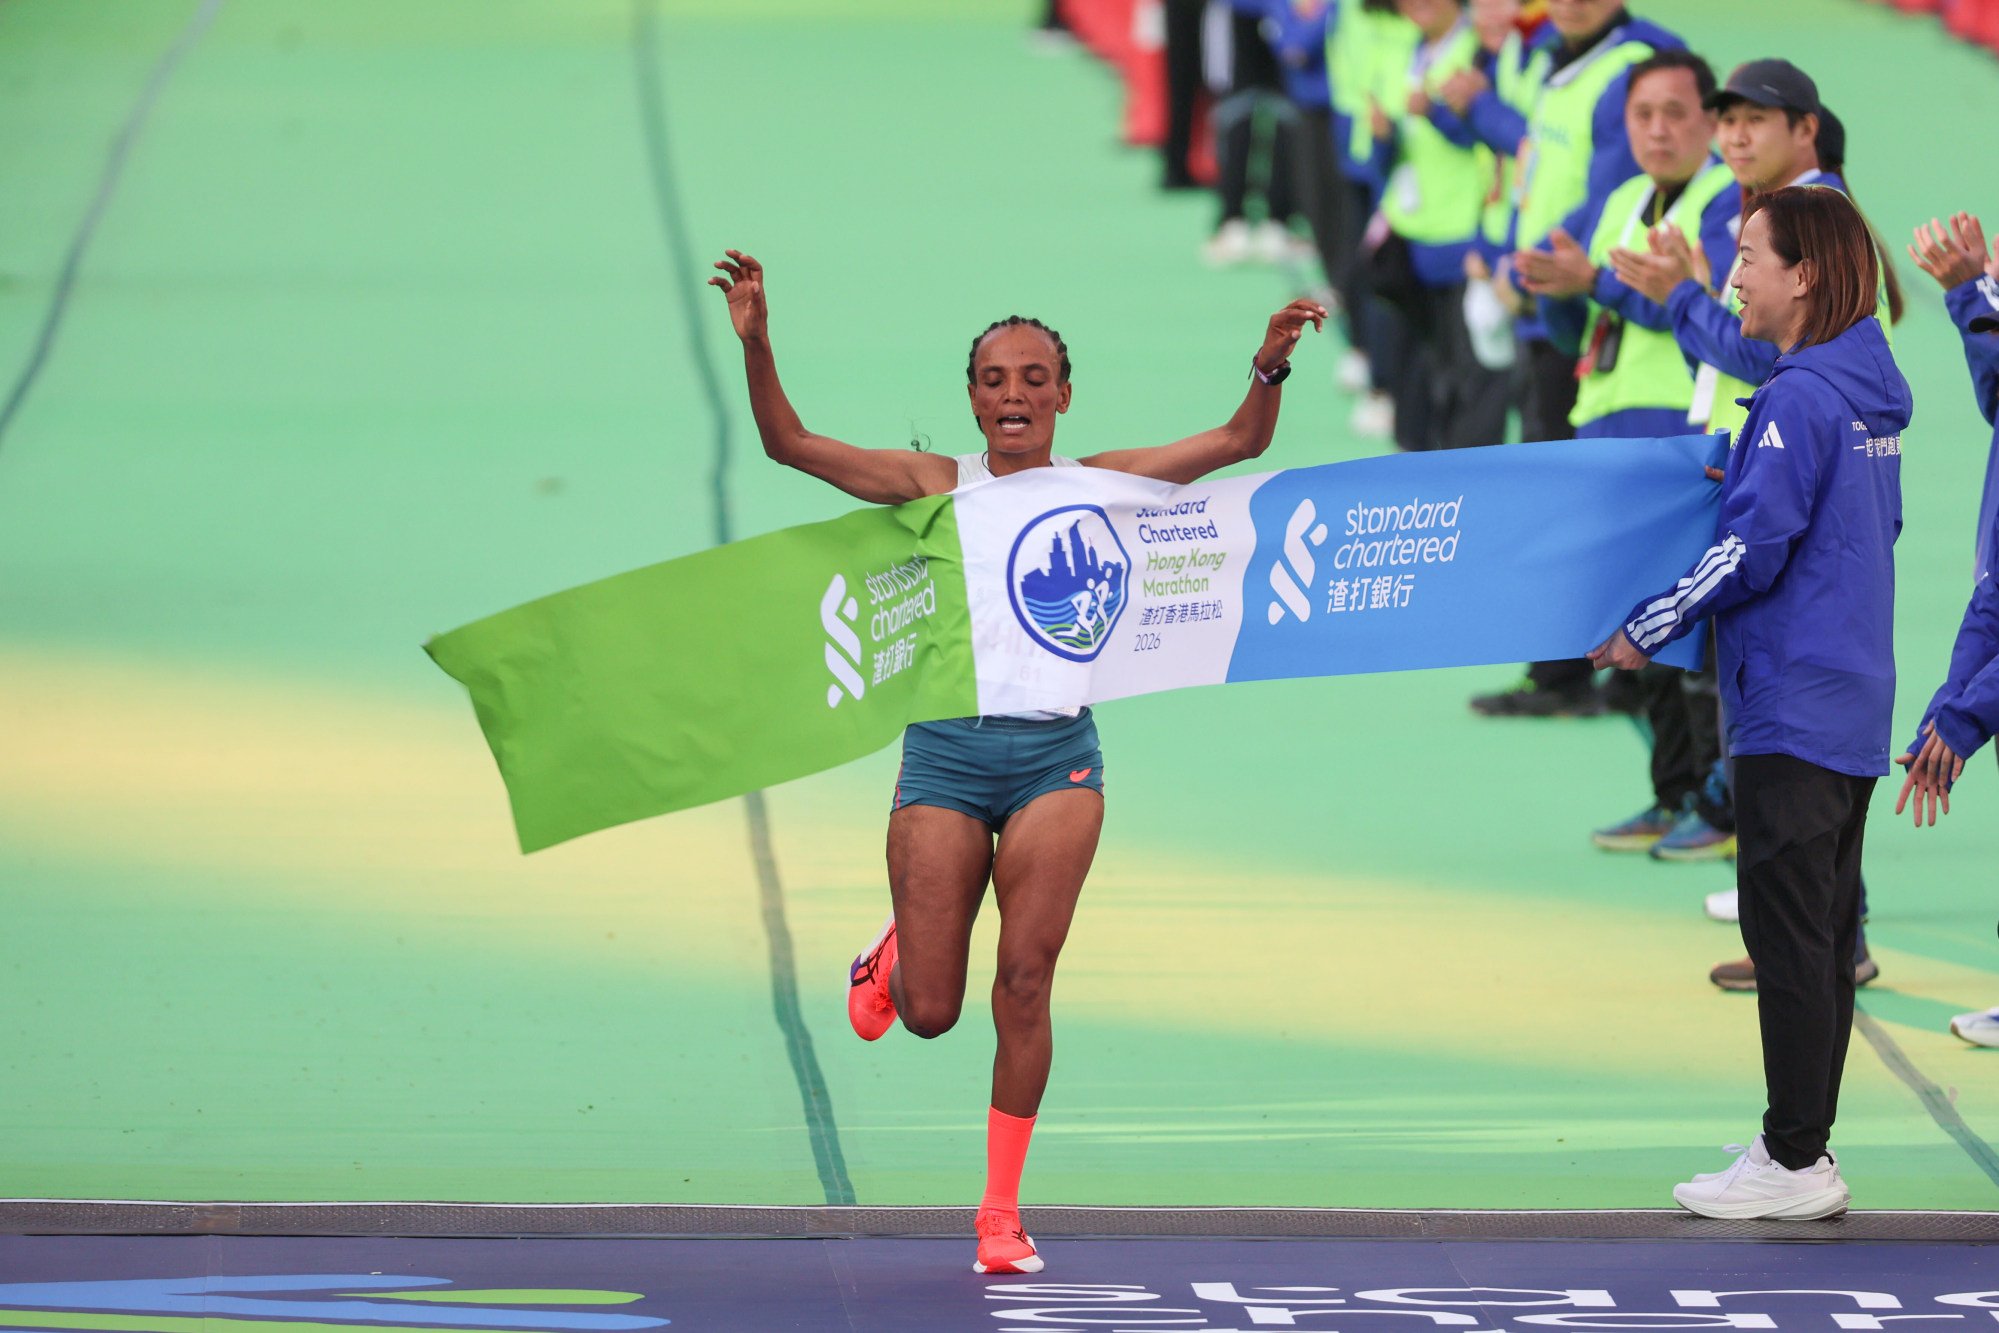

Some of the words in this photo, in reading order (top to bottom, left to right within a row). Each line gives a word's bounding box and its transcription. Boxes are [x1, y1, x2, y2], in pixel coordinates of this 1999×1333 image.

[1345, 495, 1464, 536] standard
[1139, 520, 1219, 544] Chartered
[1146, 552, 1184, 574] Hong
[1188, 548, 1228, 571] Kong
[1334, 530, 1461, 570] chartered
[1143, 574, 1209, 598] Marathon
[1327, 574, 1415, 614] 渣打銀行
[871, 580, 936, 642] chartered
[1139, 600, 1222, 626] 渣打香港馬拉松
[1134, 633, 1161, 652] 2026
[873, 633, 917, 687] 渣打銀行
[990, 1306, 1999, 1329] char
